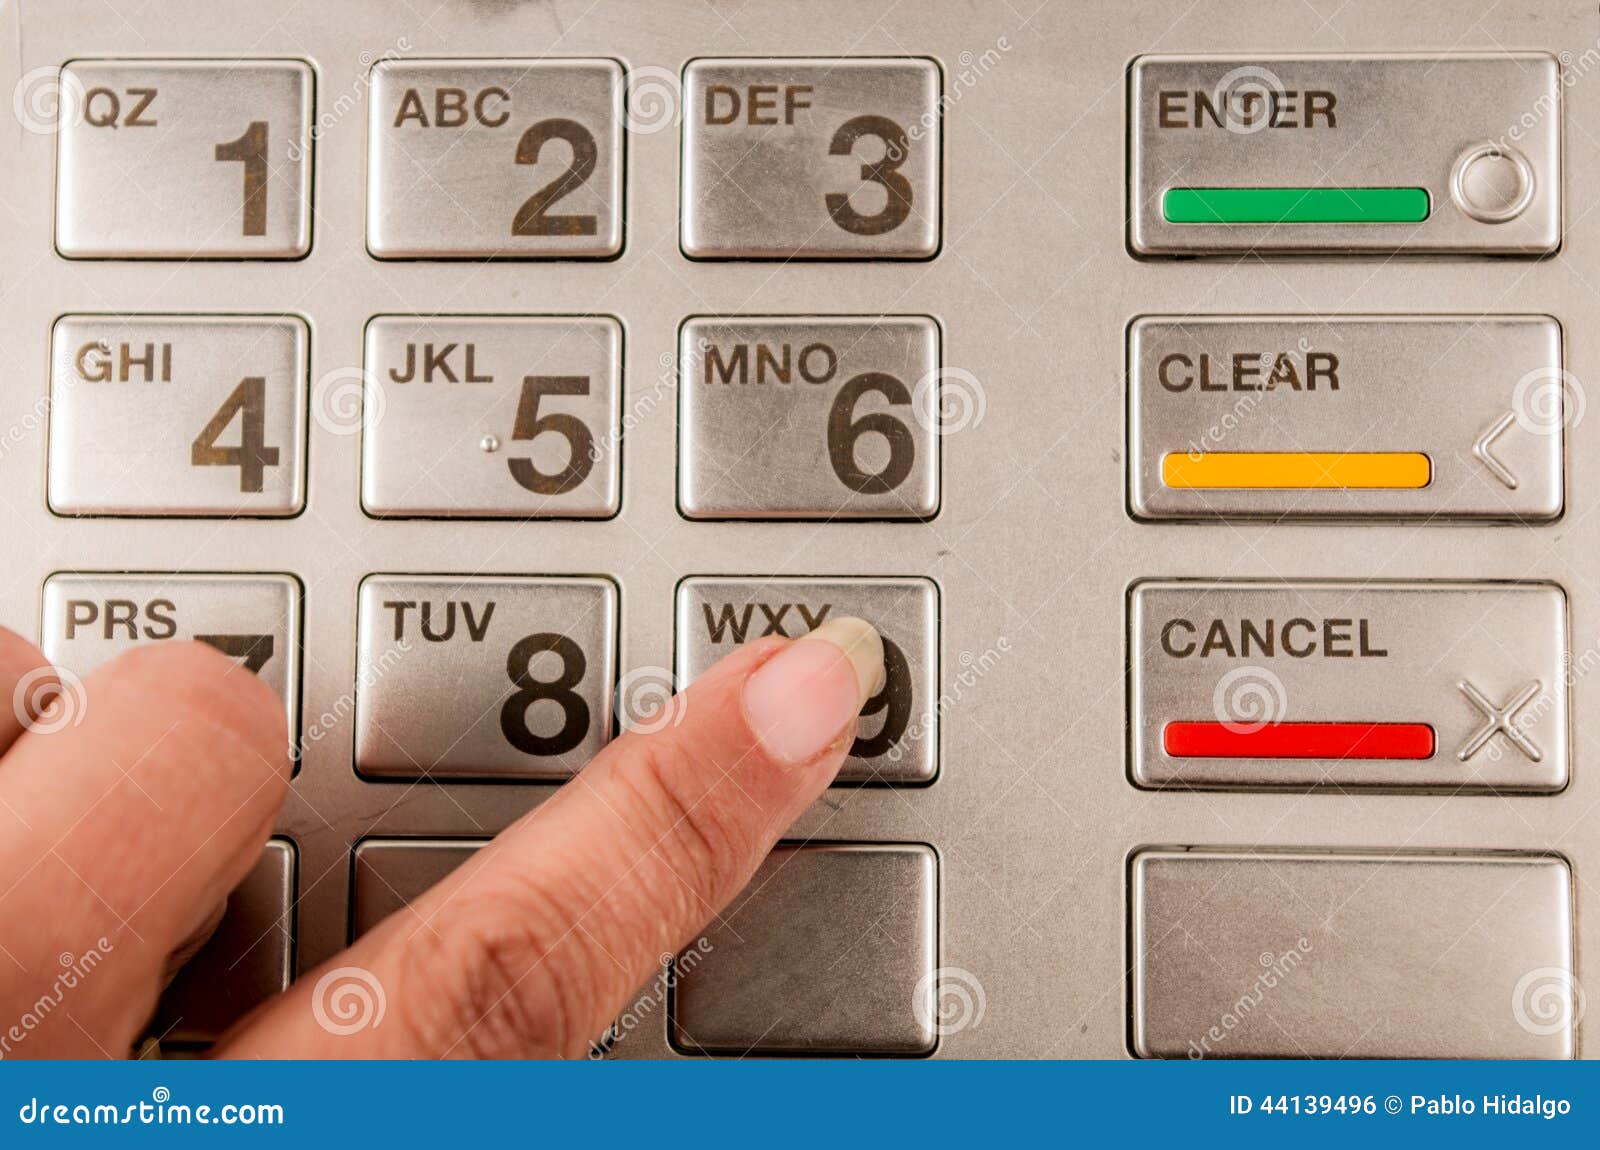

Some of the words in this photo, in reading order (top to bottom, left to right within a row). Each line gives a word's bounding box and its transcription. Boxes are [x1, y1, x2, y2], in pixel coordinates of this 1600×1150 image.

[83, 87, 158, 129] QZ
[394, 86, 511, 129] ABC
[705, 84, 814, 126] DEF
[1158, 90, 1338, 129] ENTER
[214, 121, 269, 237] 1
[510, 118, 598, 237] 2
[824, 114, 914, 237] 3
[76, 341, 172, 383] GHI
[389, 343, 494, 384] JKL
[704, 342, 838, 385] MNO
[1158, 352, 1340, 394] CLEAR
[191, 376, 280, 494] 4
[507, 375, 596, 496] 5
[827, 372, 915, 495] 6
[66, 598, 178, 640] PRS
[383, 600, 497, 643] TUV
[702, 603, 832, 644] WXY
[1160, 617, 1388, 659] CANCEL
[500, 632, 591, 757] 8
